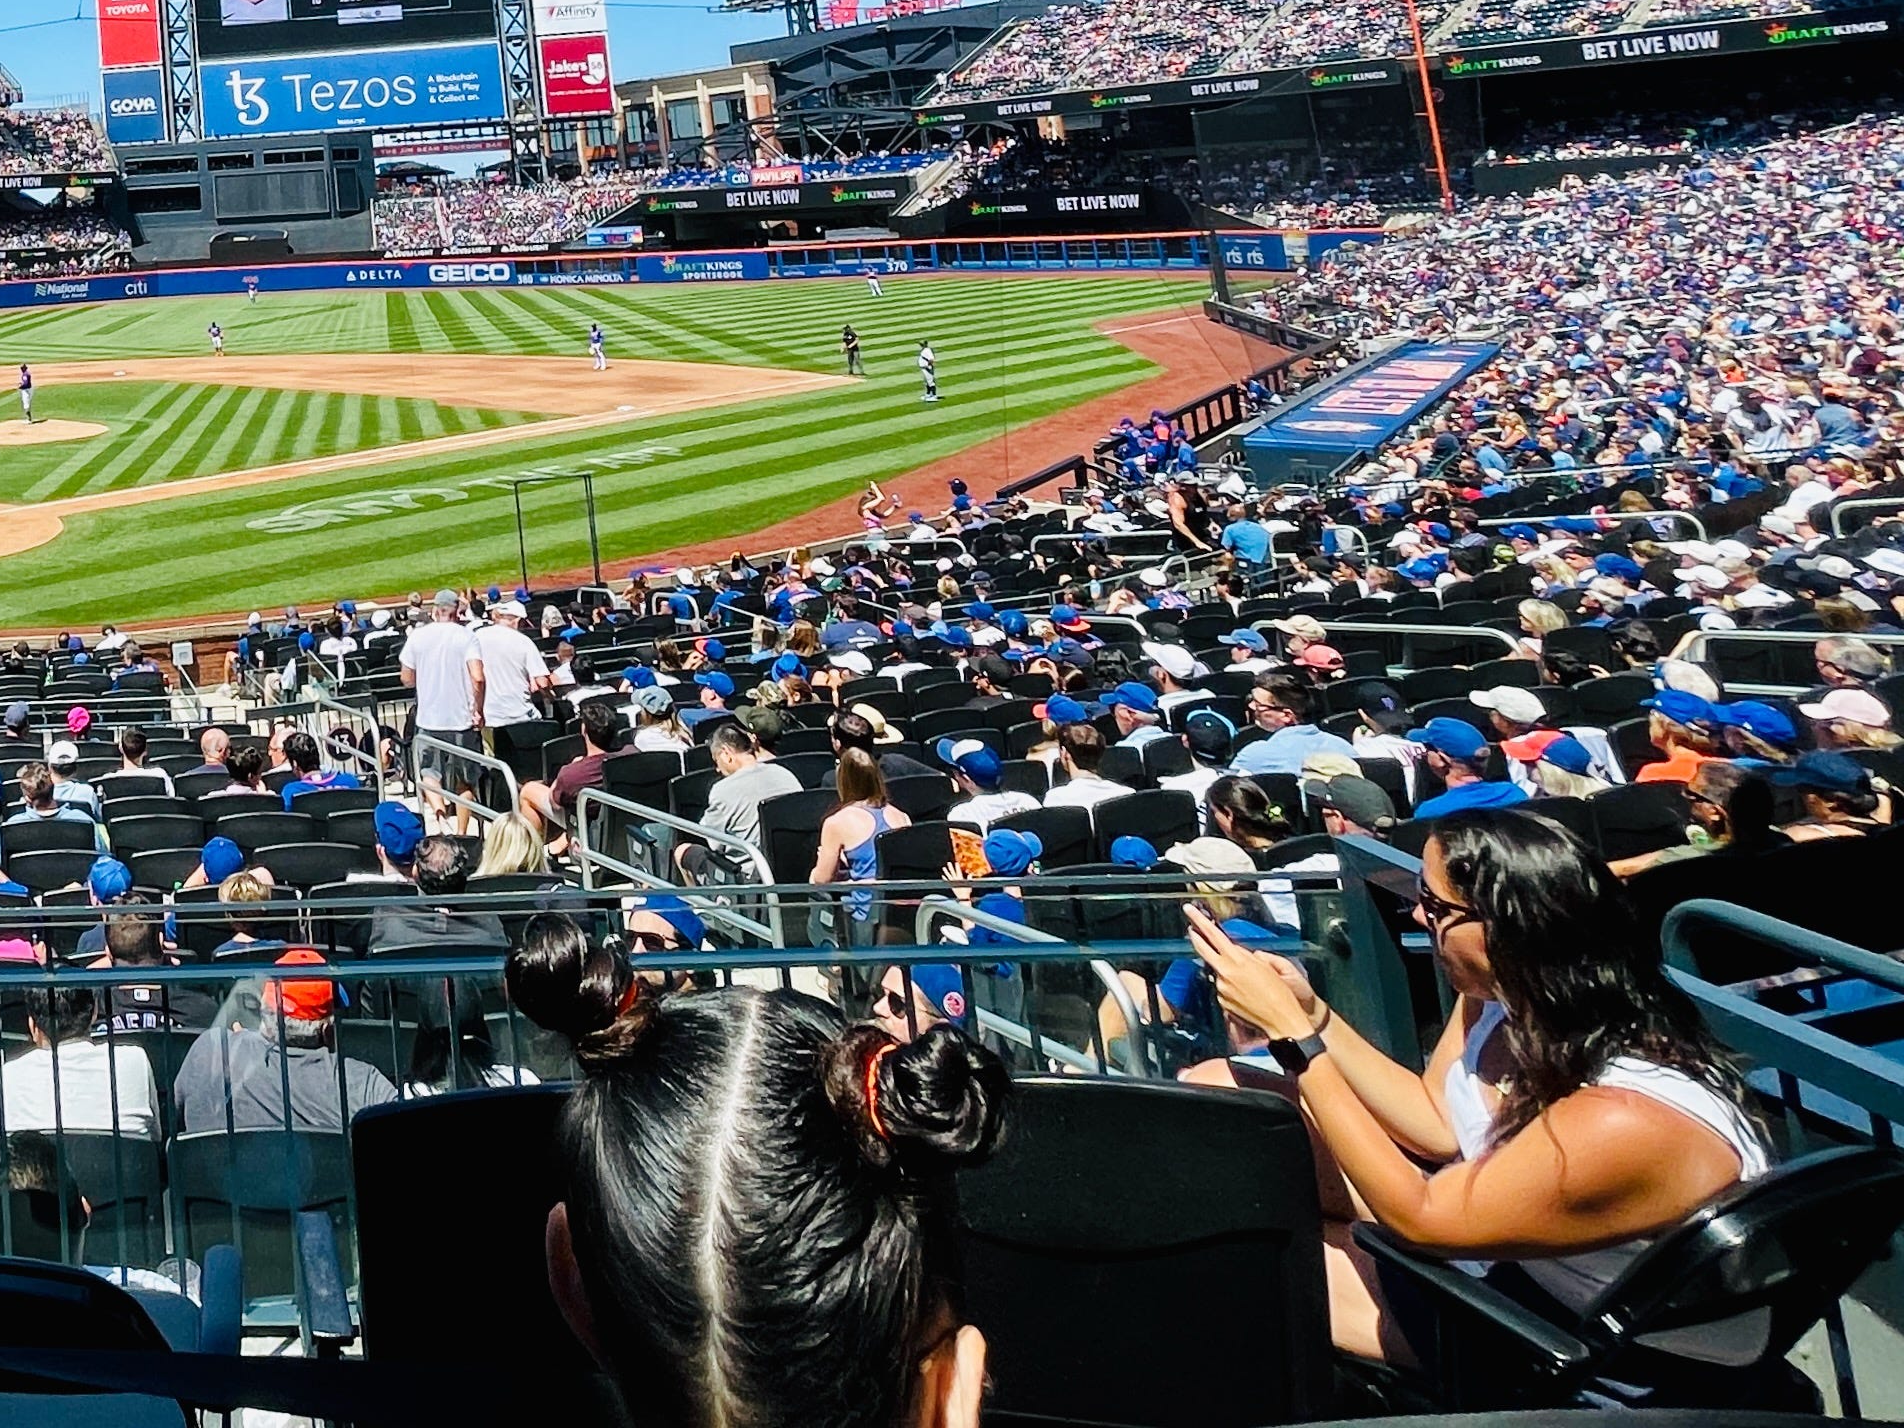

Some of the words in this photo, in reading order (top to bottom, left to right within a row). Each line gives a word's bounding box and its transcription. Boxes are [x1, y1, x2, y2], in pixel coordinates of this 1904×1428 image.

[105, 3, 150, 16] TOYOTA
[555, 5, 597, 18] Affinity
[1767, 20, 1889, 44] DRAFTKINGS
[1582, 41, 1618, 61] BET
[1623, 36, 1666, 57] LIVE
[1669, 31, 1720, 52] NOW
[1449, 55, 1542, 73] DRAFTKINGS
[282, 74, 417, 112] Tezos
[1191, 84, 1210, 96] BET
[1211, 81, 1233, 94] LIVE
[1234, 79, 1260, 92] NOW
[110, 97, 157, 113] GOYA
[998, 103, 1013, 115] BET
[1014, 102, 1032, 114] LIVE
[5, 178, 22, 188] LIVE
[726, 192, 746, 207] BET
[747, 191, 772, 206] LIVE
[772, 189, 800, 205] NOW
[1056, 197, 1078, 211] BET
[1080, 196, 1107, 210] LIVE
[1109, 194, 1140, 209] NOW
[429, 263, 510, 283] GEICO
[886, 261, 908, 272] 370
[359, 269, 402, 282] DELTA
[550, 274, 584, 284] KONICA
[585, 272, 624, 283] MINOLTA
[47, 282, 89, 295] National
[125, 281, 147, 295] citi
